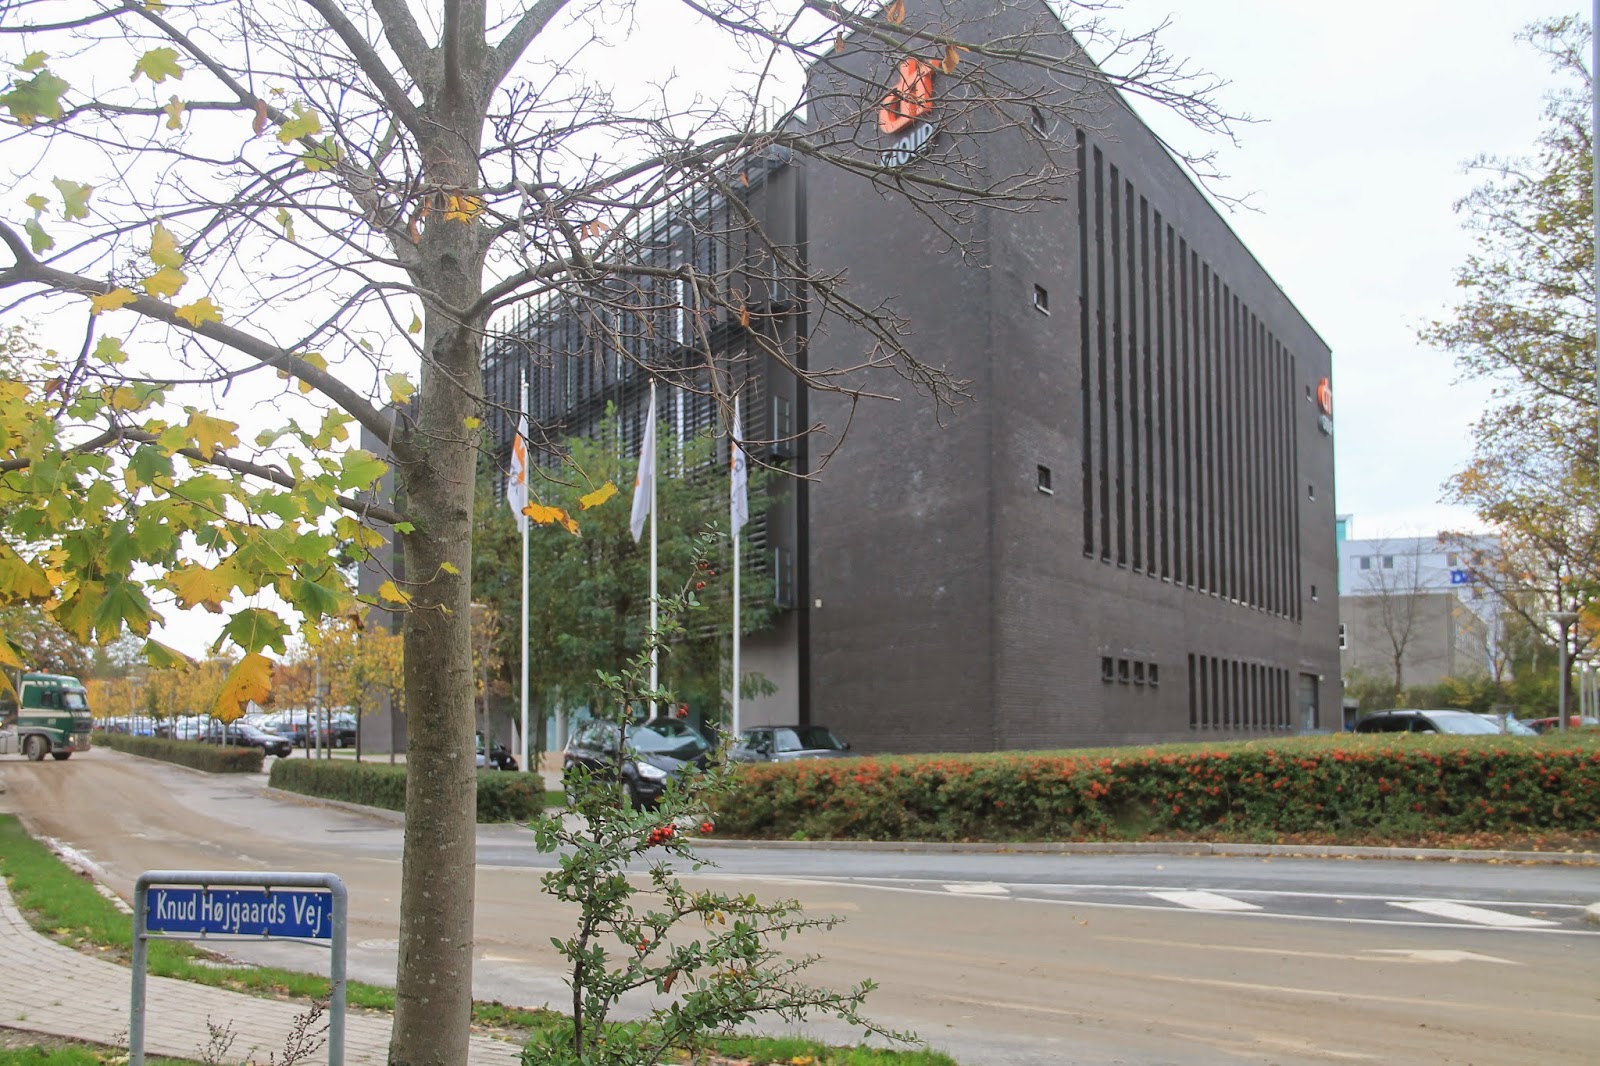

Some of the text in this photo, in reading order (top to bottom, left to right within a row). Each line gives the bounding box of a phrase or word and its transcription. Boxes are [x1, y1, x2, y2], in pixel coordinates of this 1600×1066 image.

[156, 892, 323, 935] Knud Højgaards Vej
